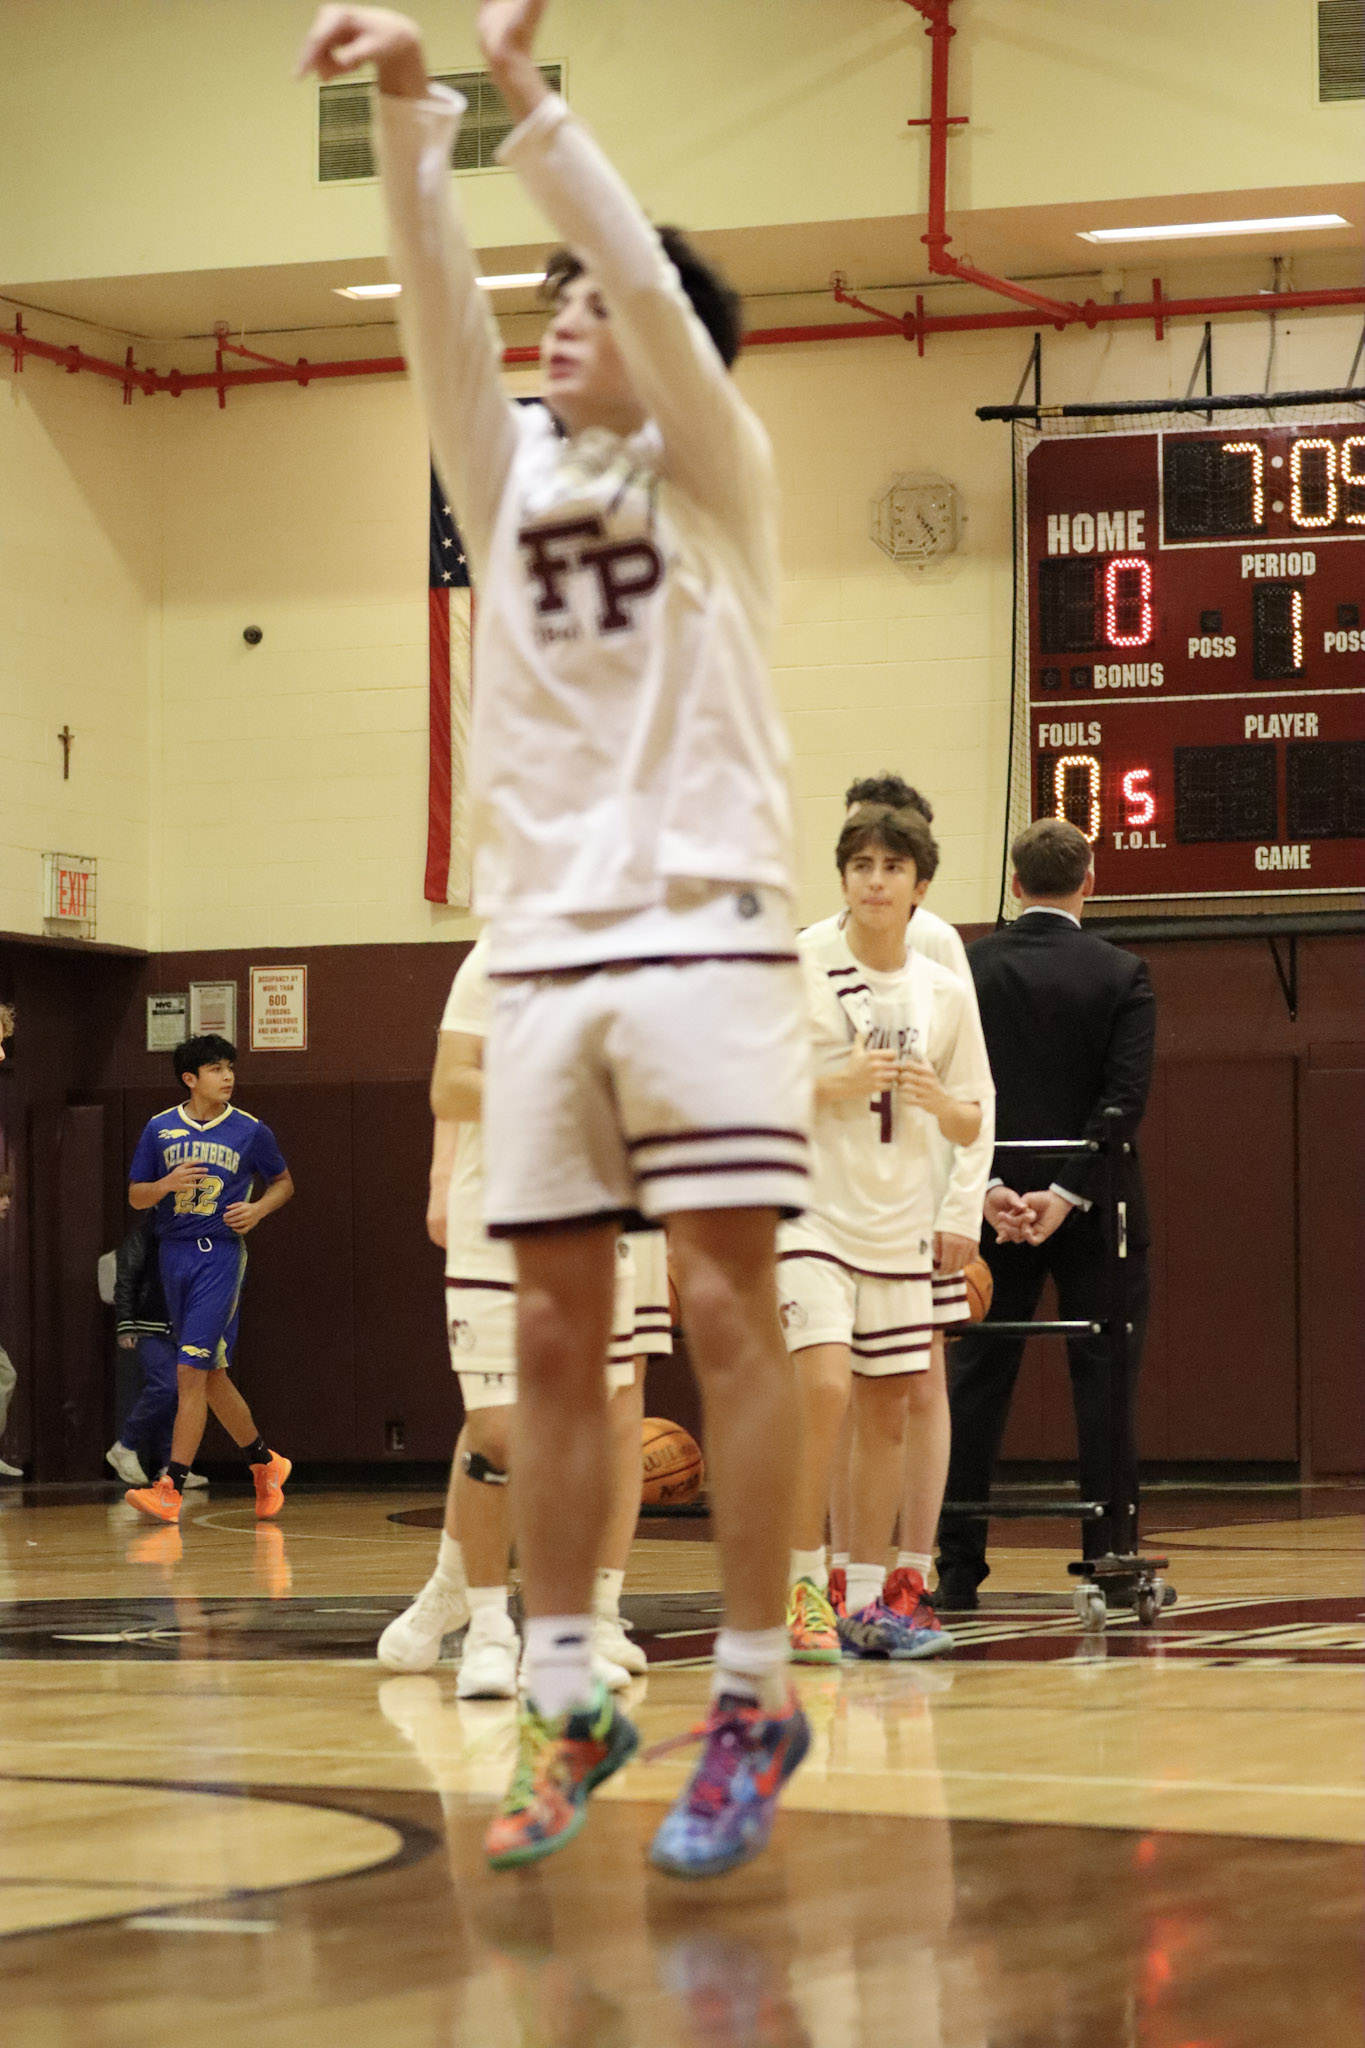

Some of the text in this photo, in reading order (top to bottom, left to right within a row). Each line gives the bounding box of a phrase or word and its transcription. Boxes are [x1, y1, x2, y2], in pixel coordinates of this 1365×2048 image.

[1047, 509, 1146, 555] HOME
[1241, 551, 1317, 579] PERIOD
[1106, 557, 1152, 647] 0
[1292, 590, 1303, 669] 1
[1188, 636, 1237, 659] POSS
[1093, 662, 1165, 689] BONUS
[1038, 721, 1102, 747] FOULS
[1244, 712, 1319, 739] PLAYER
[1113, 831, 1167, 850] T.O.L.
[1254, 845, 1312, 871] GAME
[59, 870, 89, 917] EXIT
[155, 1001, 172, 1009] NYC
[268, 994, 287, 1006] 600
[265, 1017, 298, 1025] DANGEROUS
[269, 1026, 299, 1034] UNLAWFUL
